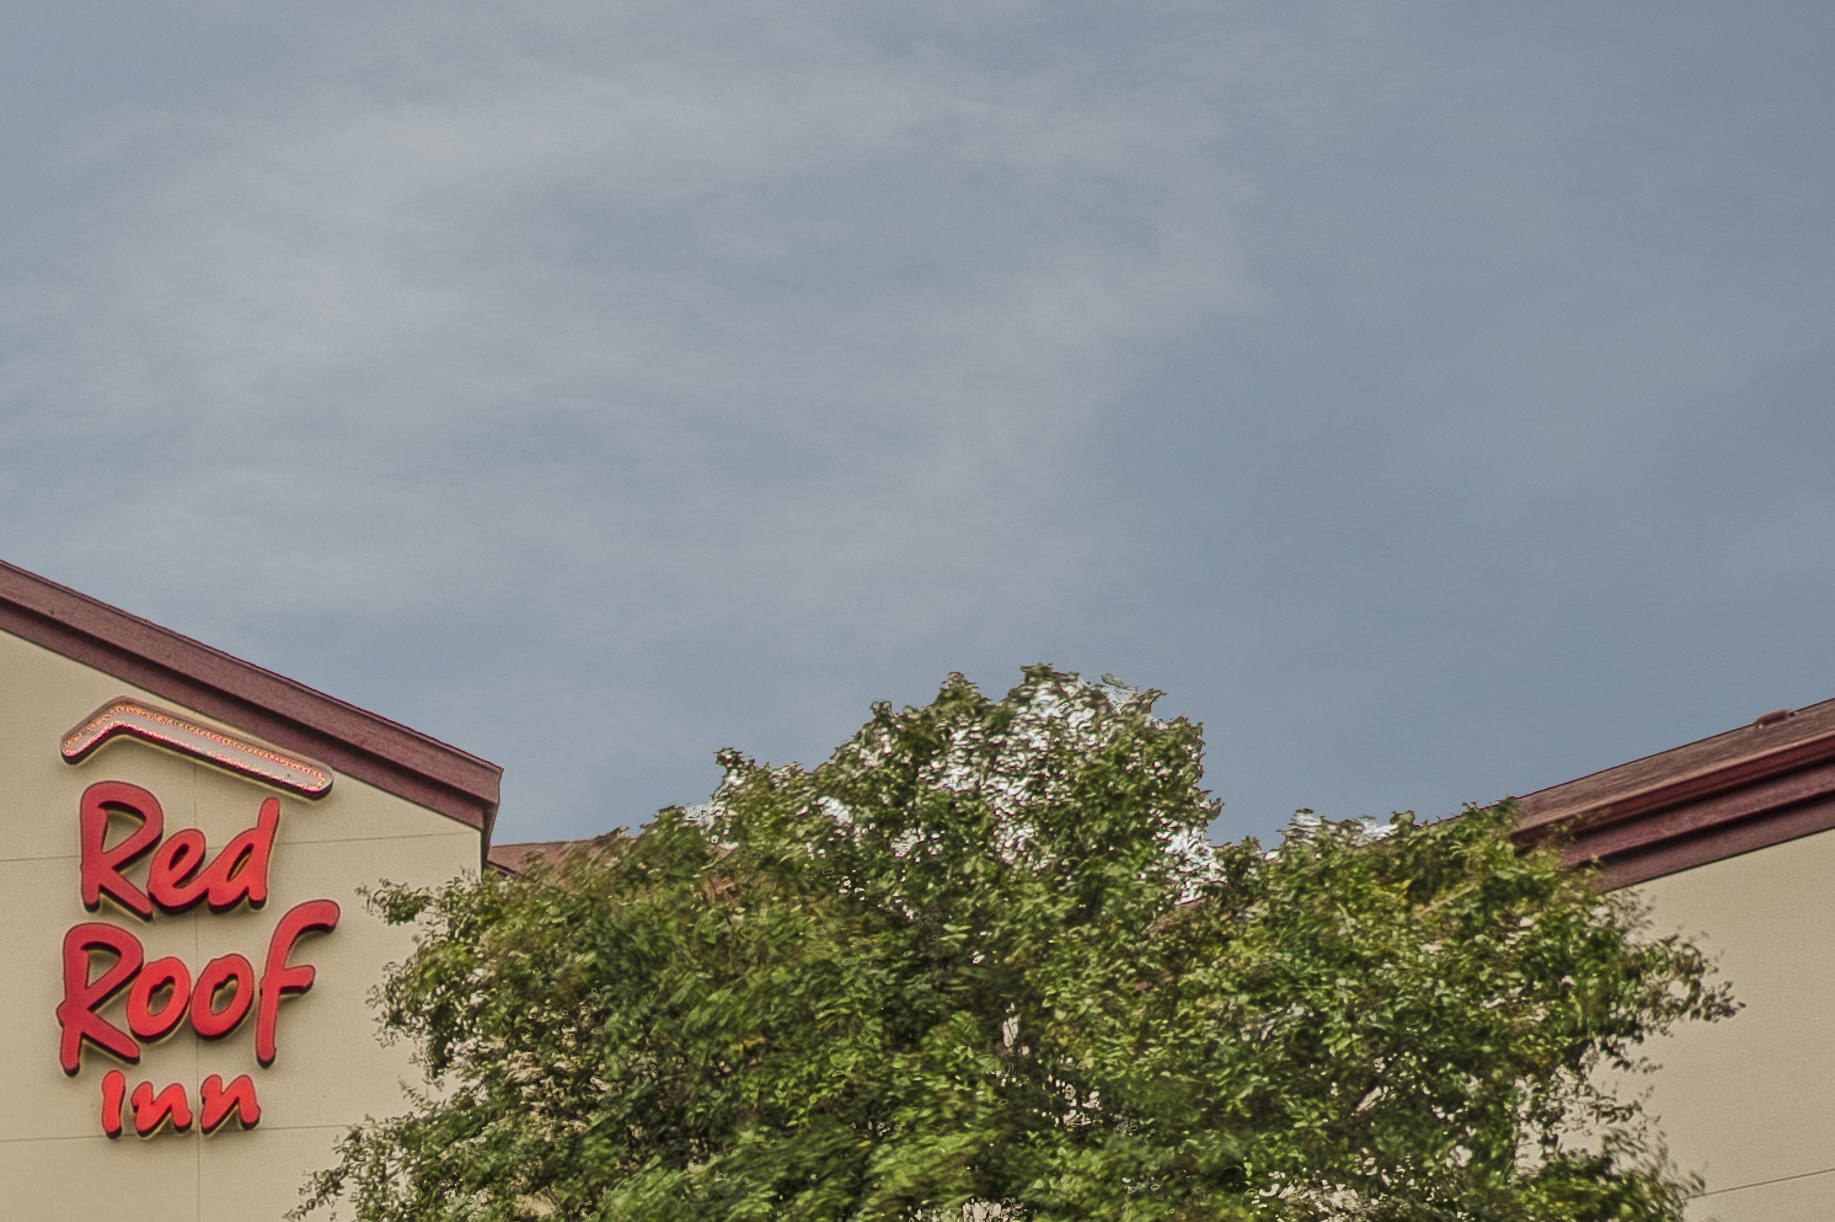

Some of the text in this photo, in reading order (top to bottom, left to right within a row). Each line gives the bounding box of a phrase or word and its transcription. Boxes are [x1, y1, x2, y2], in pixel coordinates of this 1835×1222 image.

[80, 781, 280, 920] Red
[57, 899, 340, 1076] Roof
[102, 1070, 261, 1138] Inn
